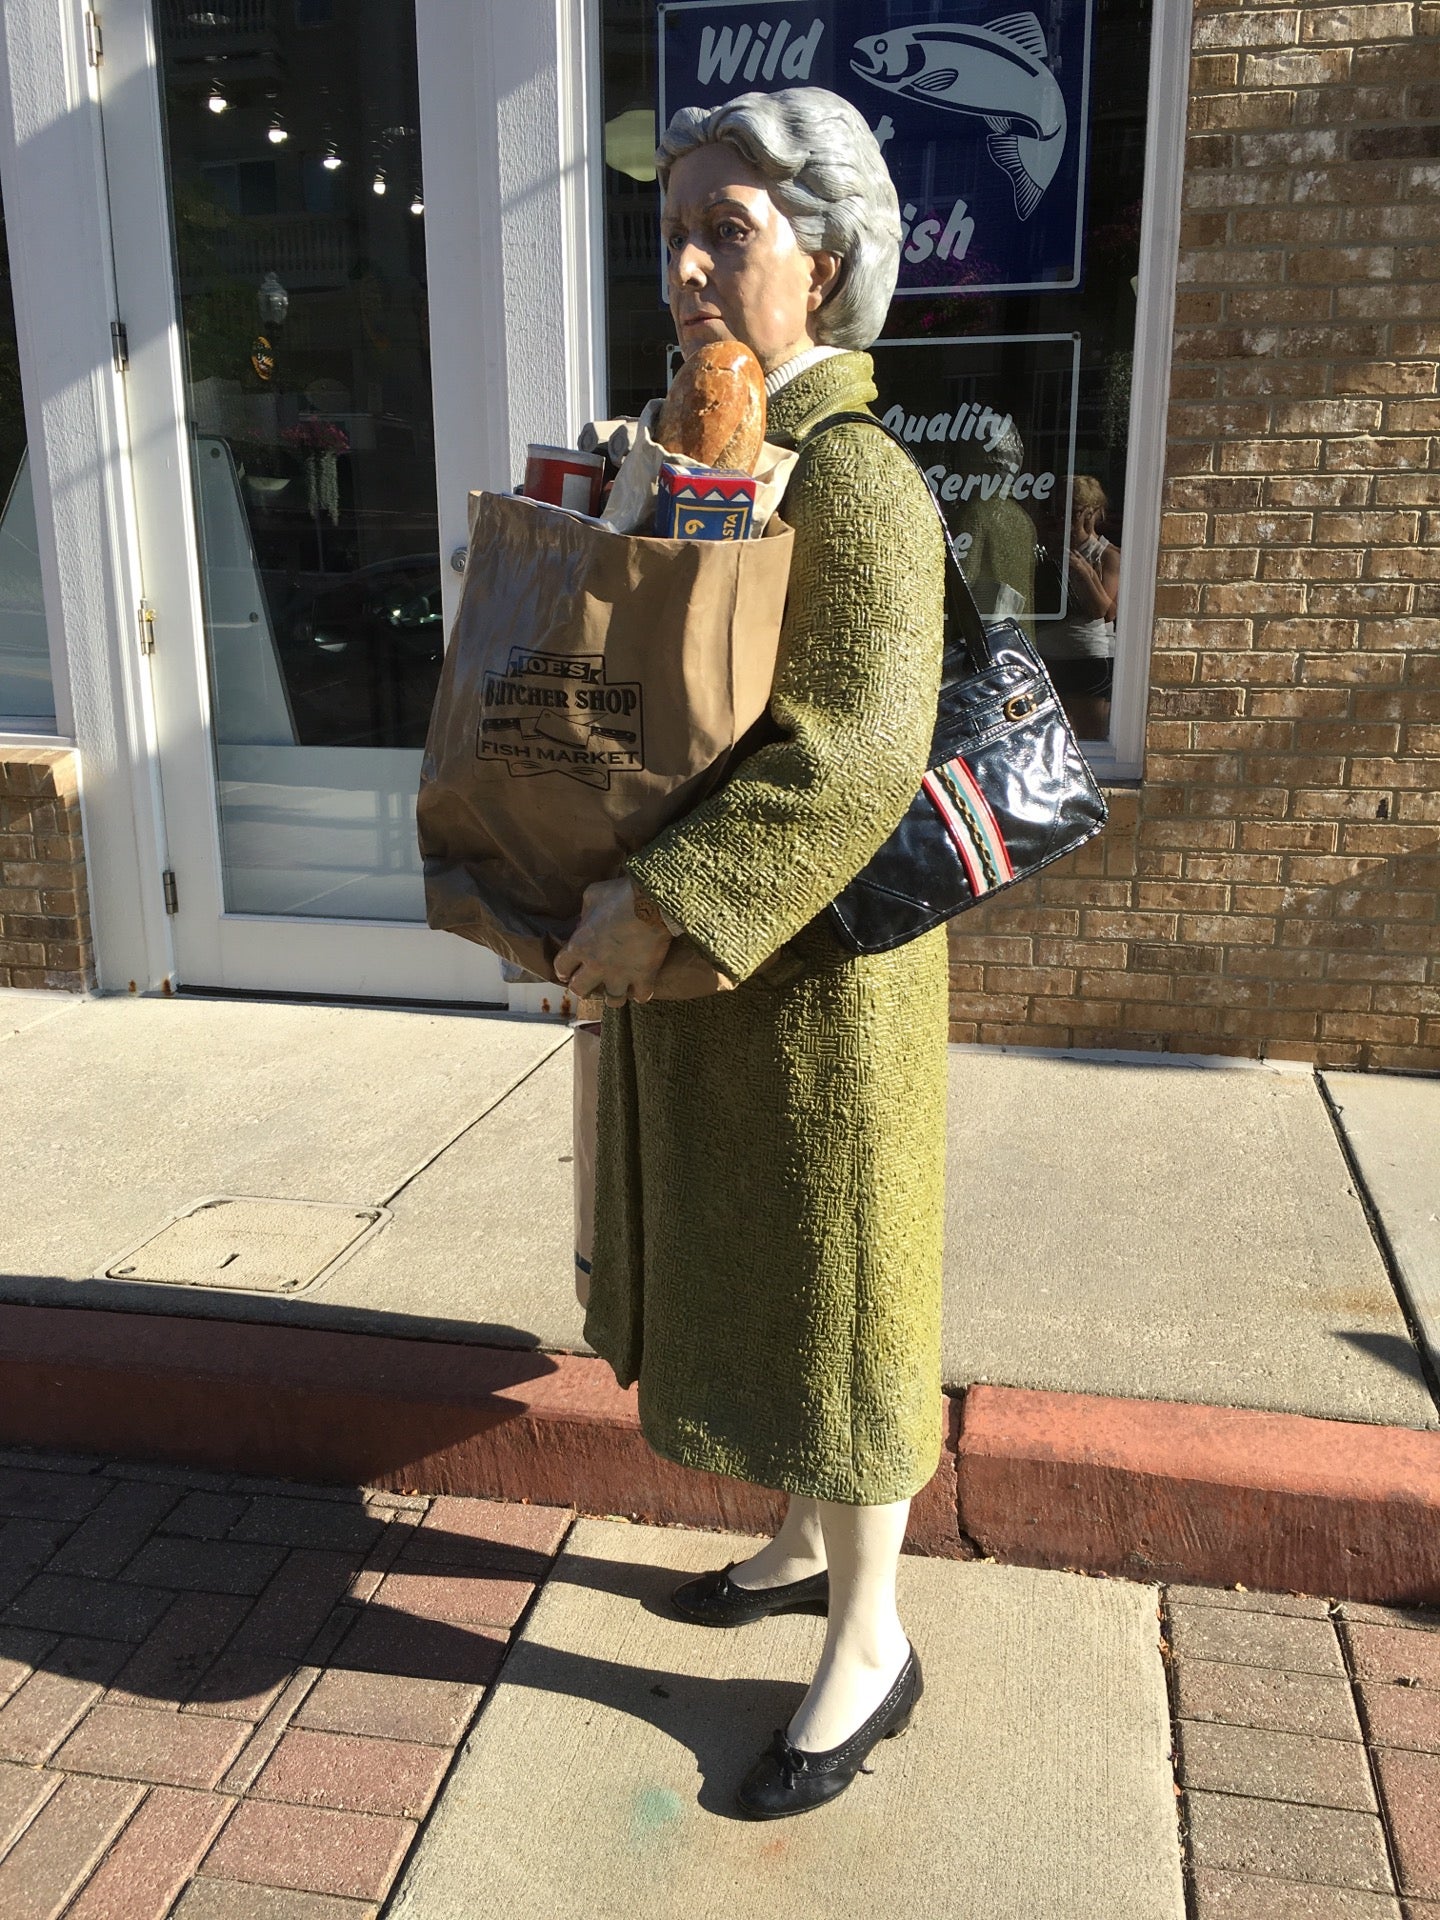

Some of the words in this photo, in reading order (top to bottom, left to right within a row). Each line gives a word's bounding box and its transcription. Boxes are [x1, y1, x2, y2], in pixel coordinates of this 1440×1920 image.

[697, 18, 825, 85] Wild
[900, 199, 976, 264] ish
[881, 402, 1013, 452] Quality
[925, 463, 1056, 501] Service
[520, 658, 586, 677] JOE'S
[485, 680, 569, 709] BUTCHER
[576, 688, 637, 716] SHOP
[481, 740, 531, 758] FISH
[539, 748, 640, 764] MARKET
